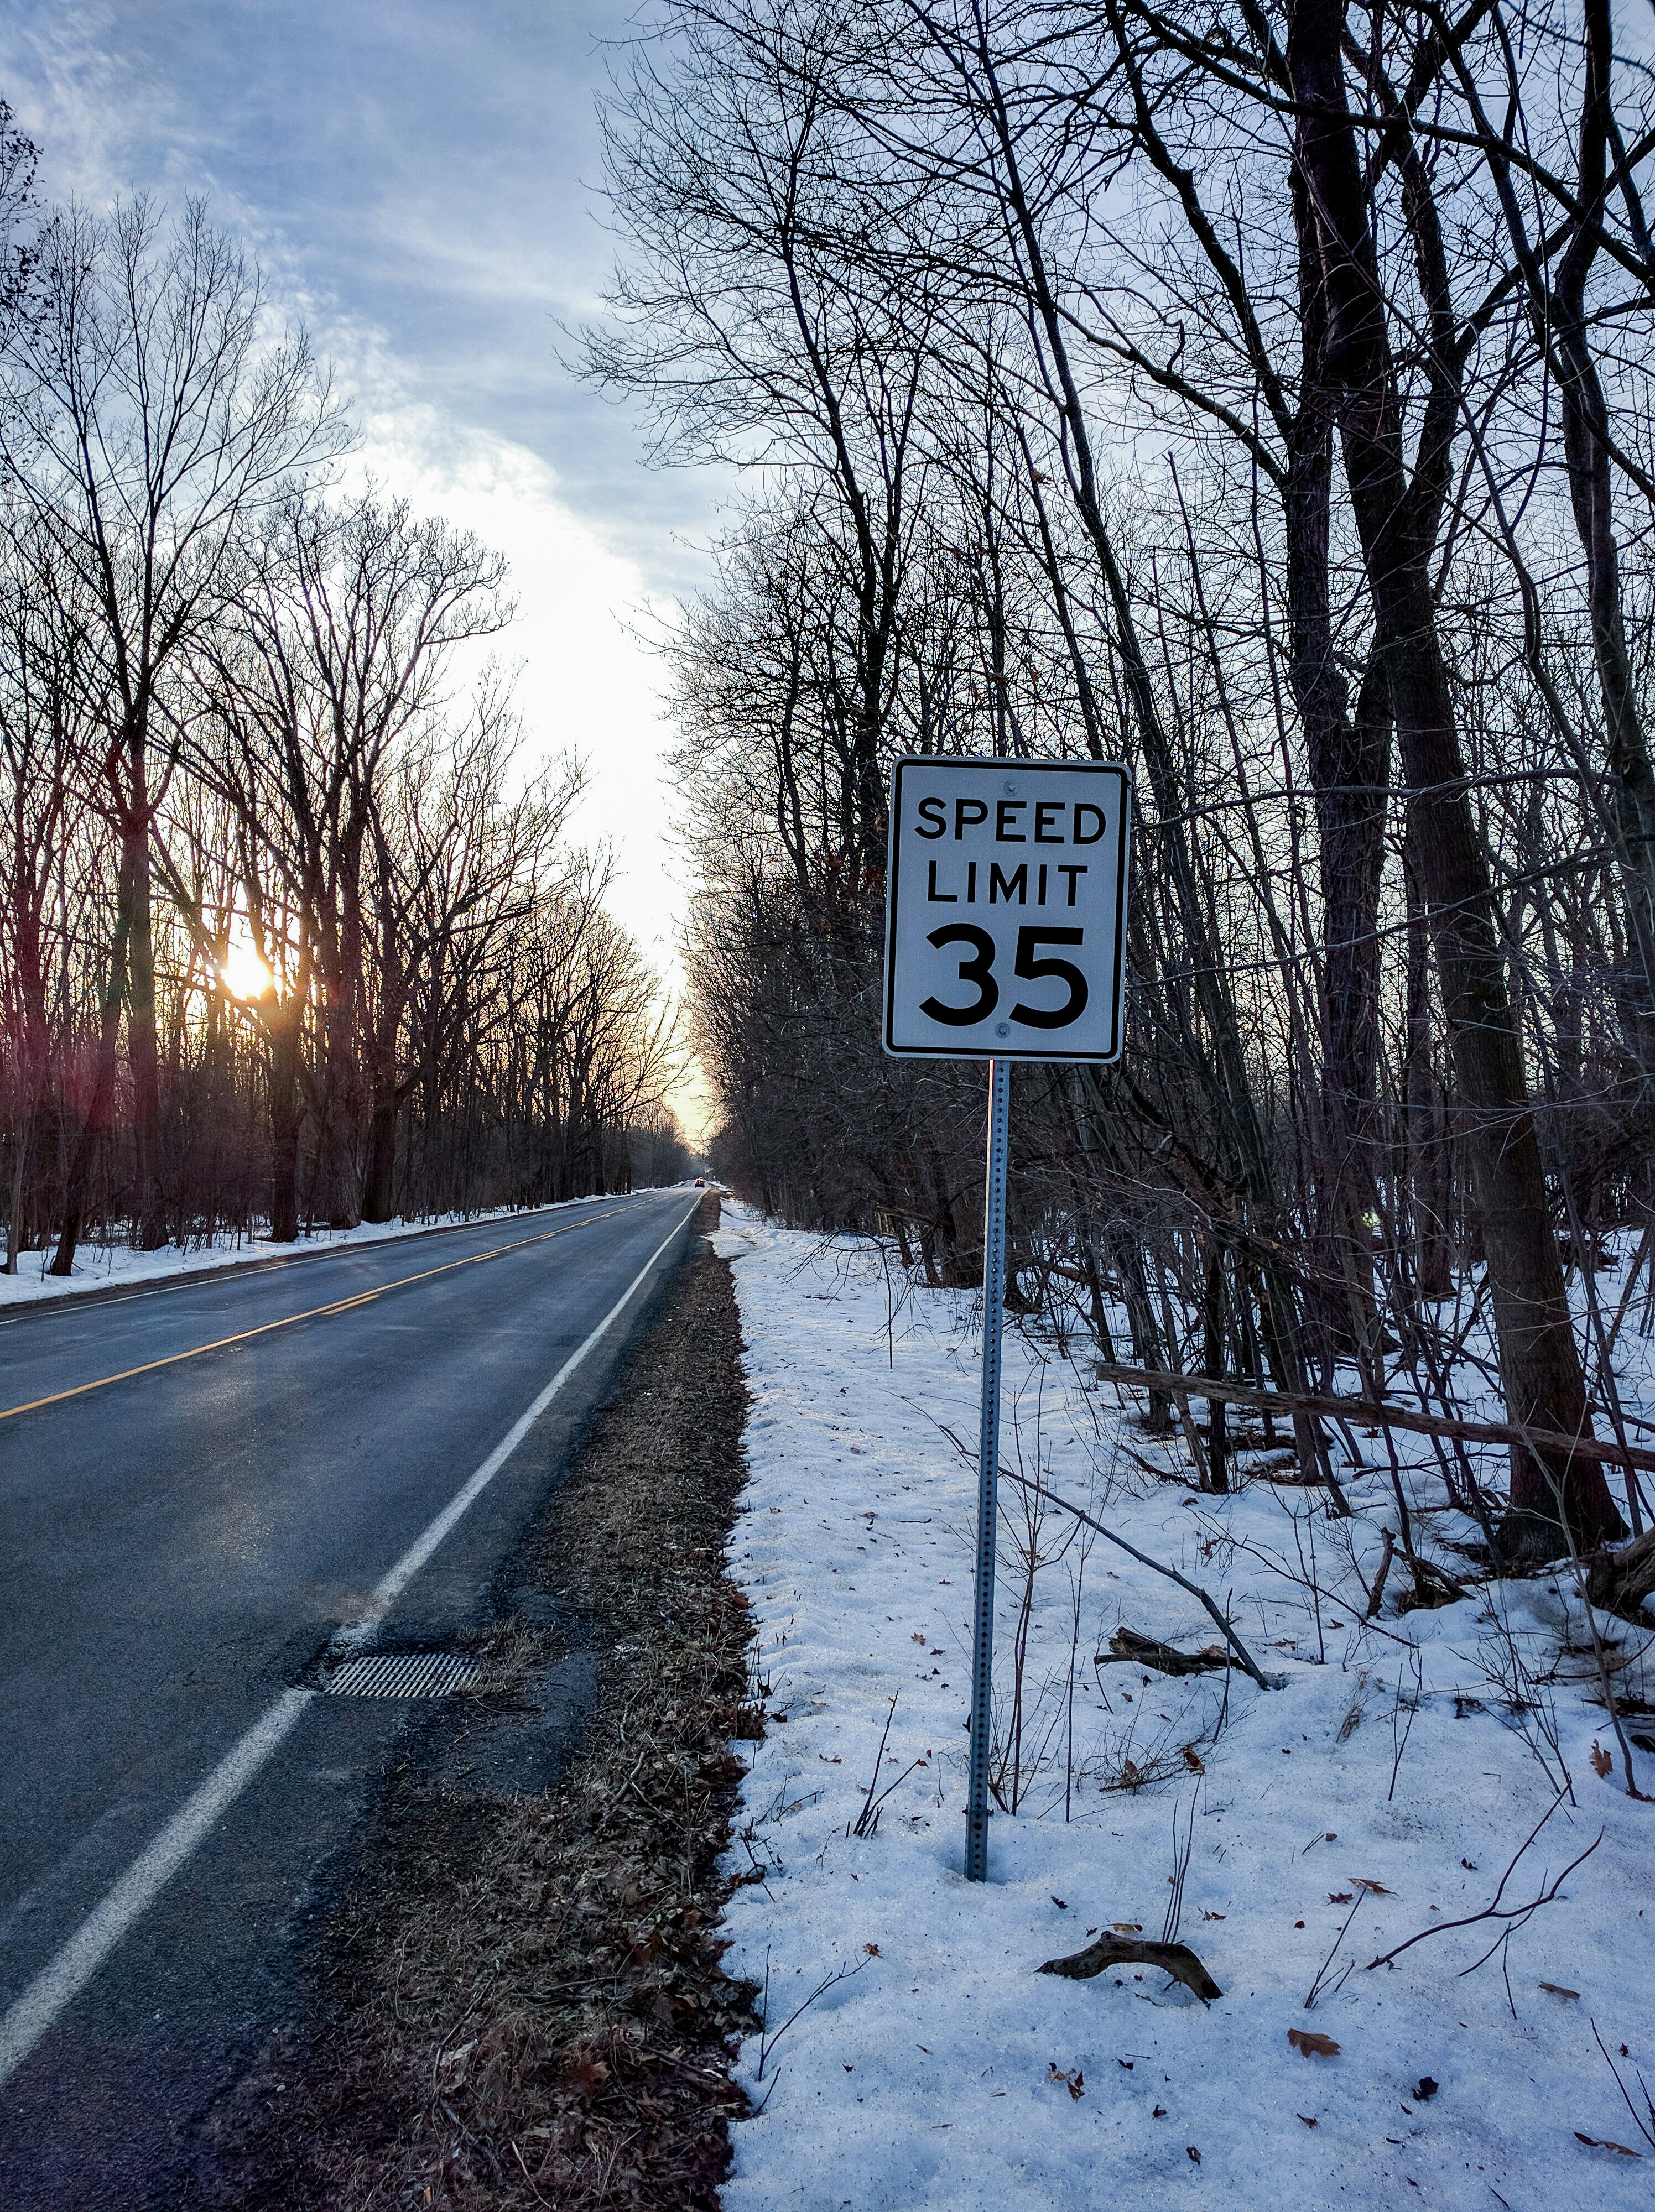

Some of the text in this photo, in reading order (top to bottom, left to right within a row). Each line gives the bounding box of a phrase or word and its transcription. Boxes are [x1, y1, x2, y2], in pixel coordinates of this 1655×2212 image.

[914, 796, 1106, 845] SPEED
[927, 859, 1089, 907] LIMIT
[918, 922, 1089, 1030] 35
